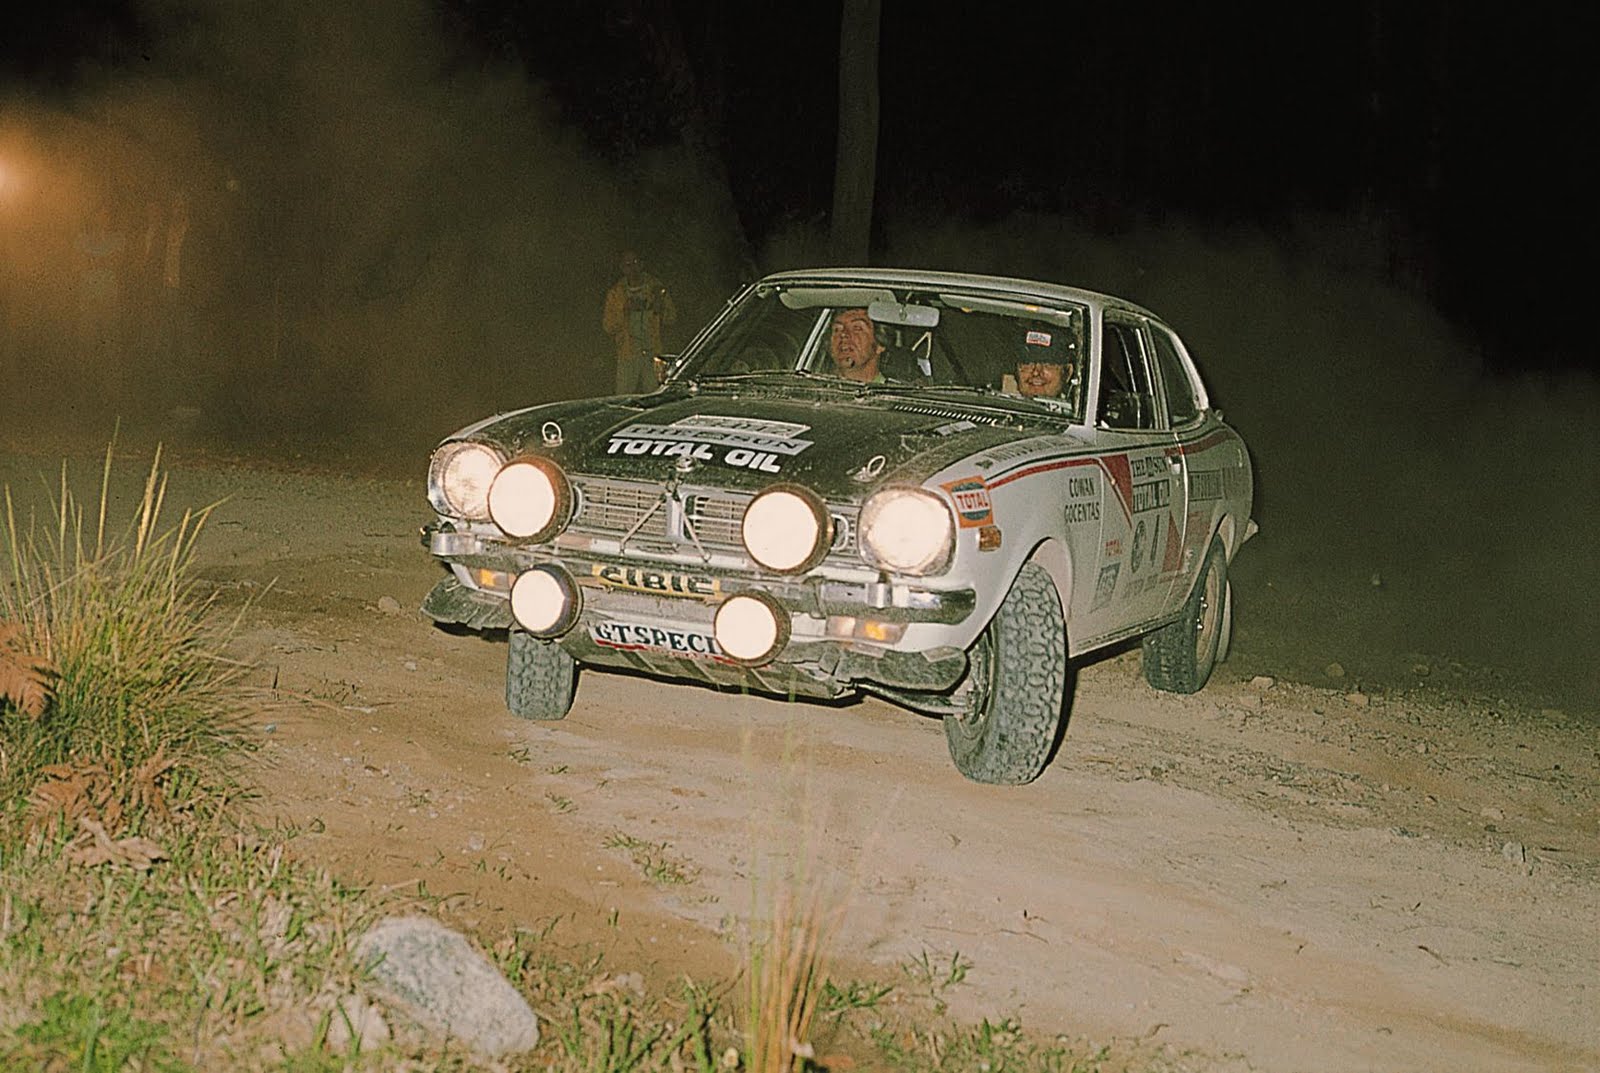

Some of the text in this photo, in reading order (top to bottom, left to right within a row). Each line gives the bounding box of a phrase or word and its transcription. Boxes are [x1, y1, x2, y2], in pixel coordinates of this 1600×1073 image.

[607, 438, 781, 473] TOTAL OIL
[1069, 478, 1095, 498] COWAN
[956, 491, 989, 511] TOTAL
[634, 627, 723, 655] SPECI
